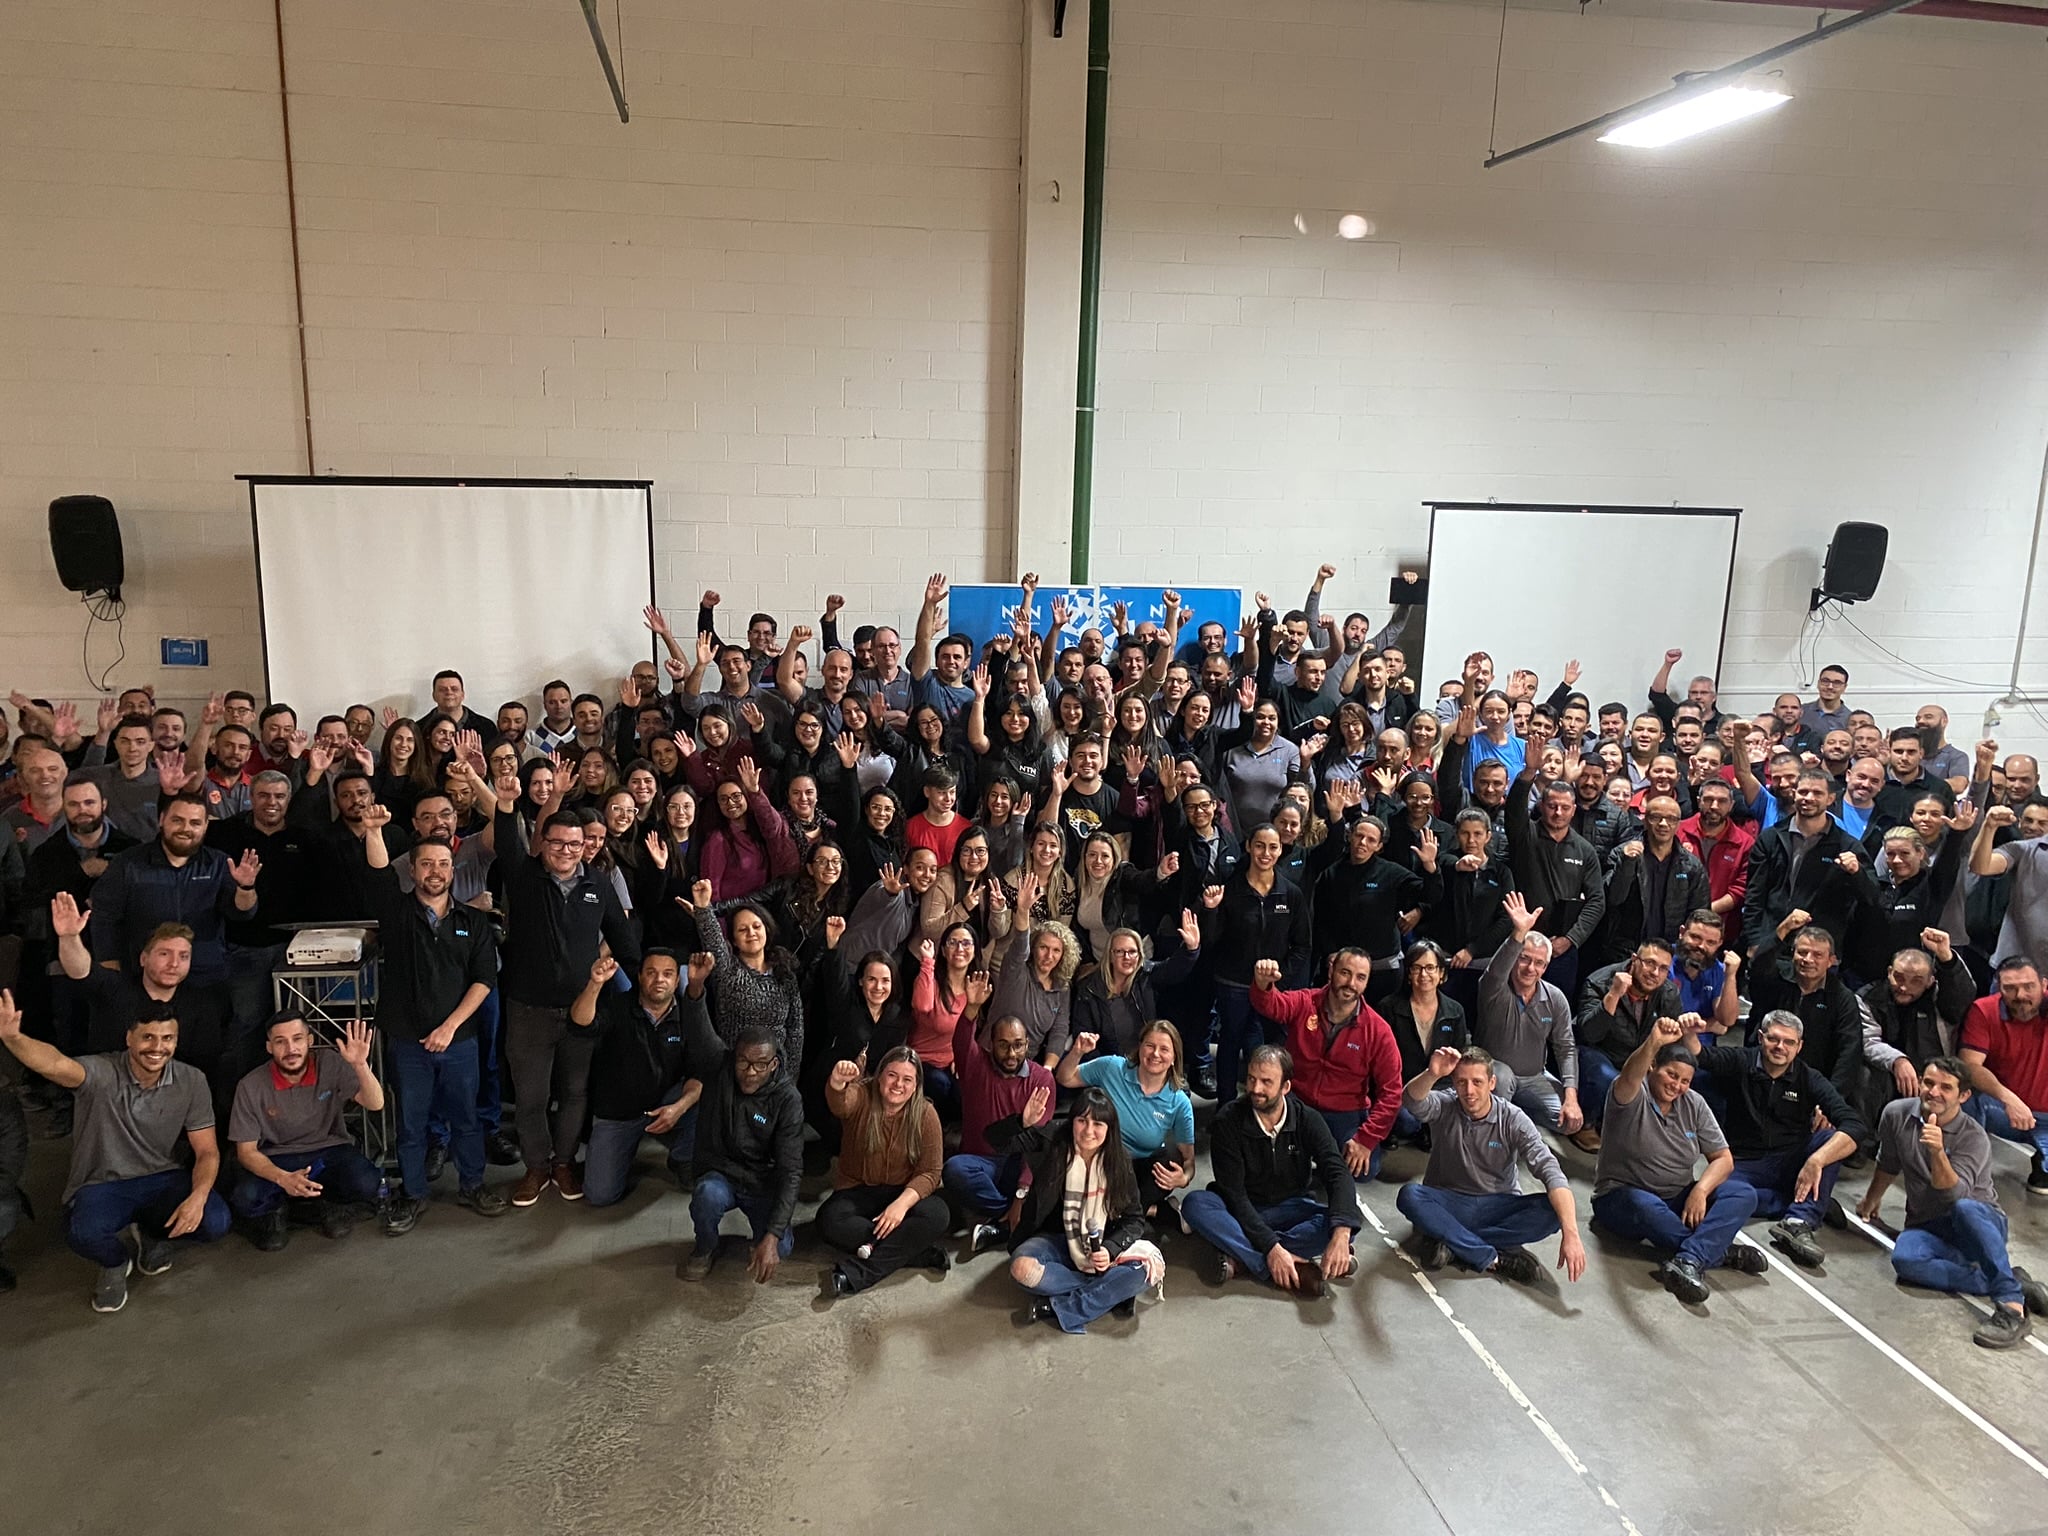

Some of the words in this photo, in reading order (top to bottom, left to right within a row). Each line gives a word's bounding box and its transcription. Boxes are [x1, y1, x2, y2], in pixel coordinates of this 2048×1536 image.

[1002, 604, 1041, 620] NN
[1019, 765, 1037, 775] NTN
[753, 1113, 767, 1124] NTN
